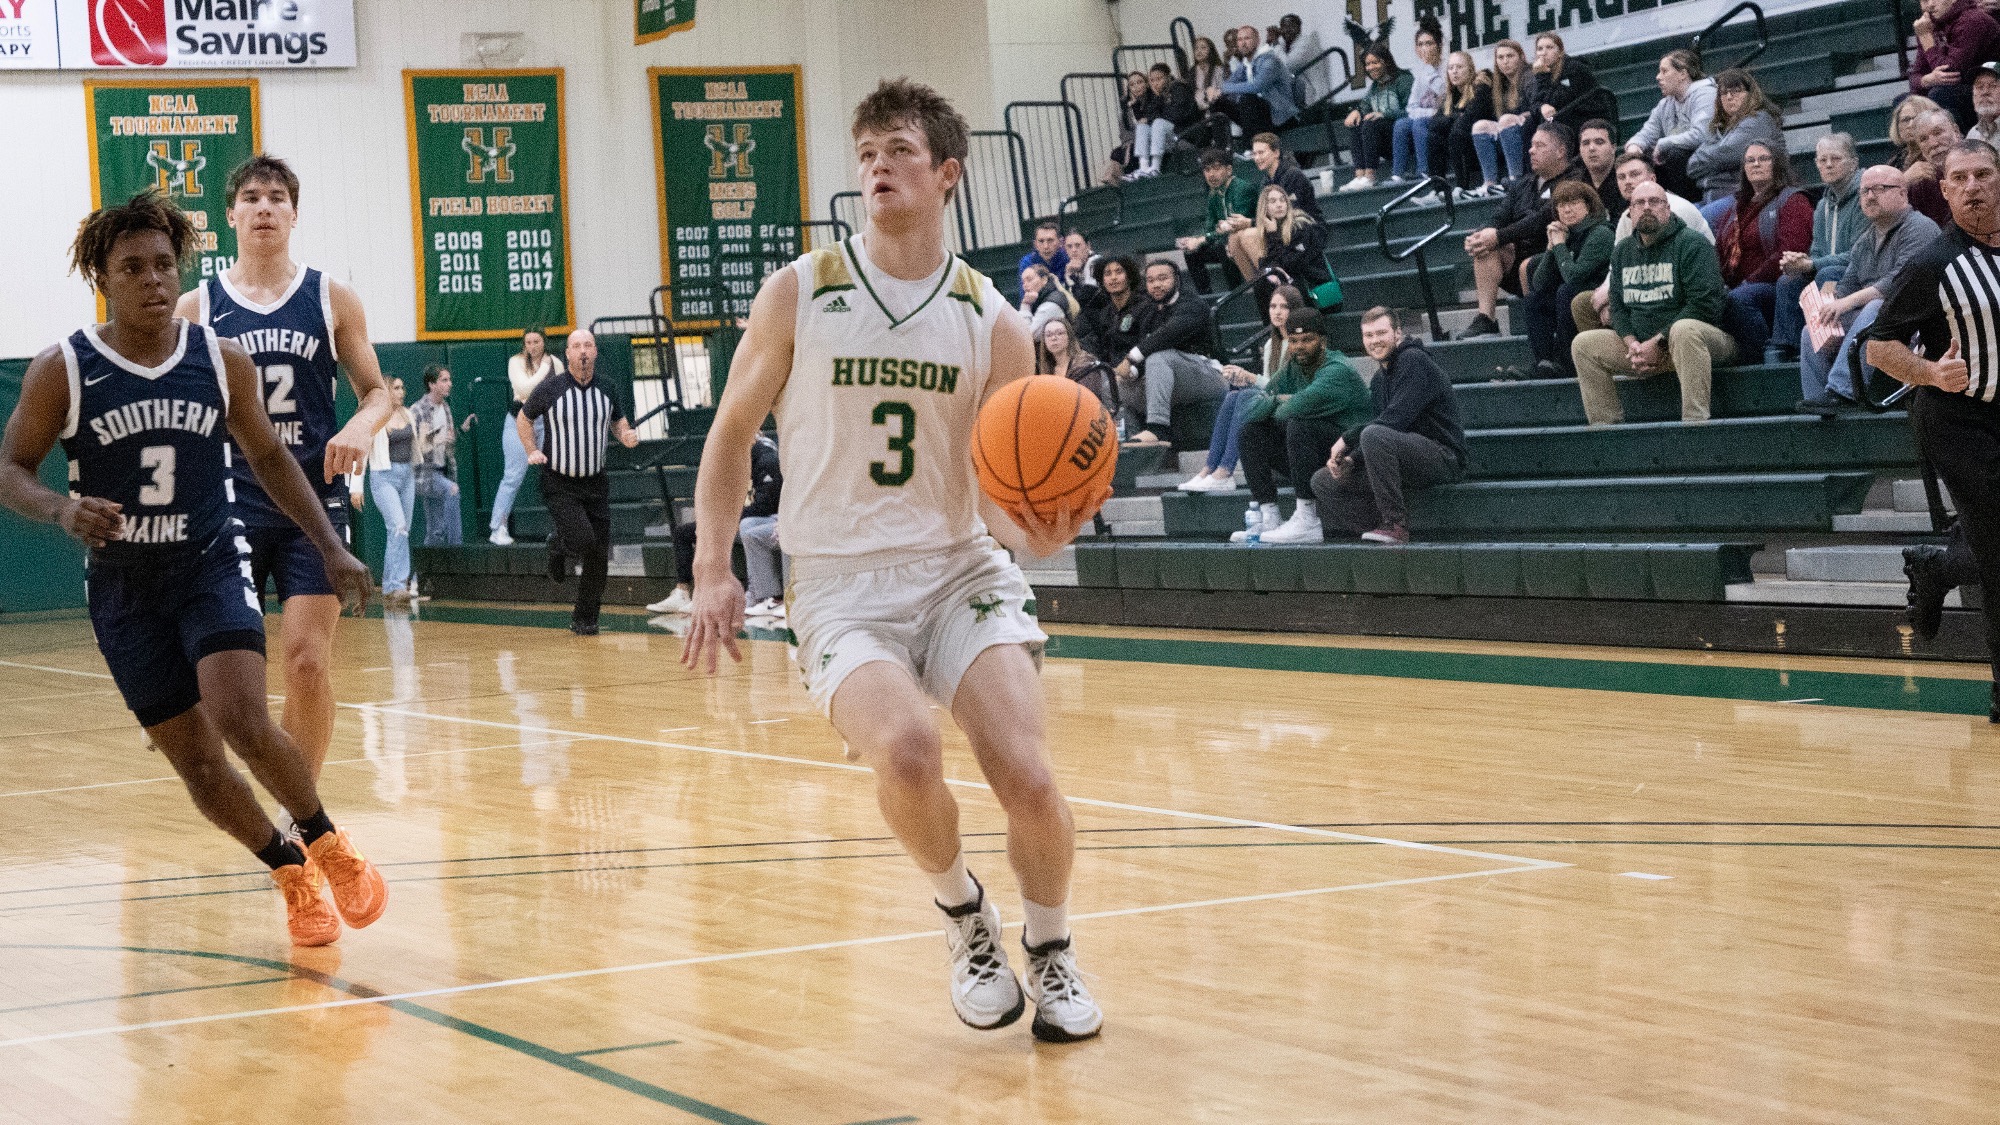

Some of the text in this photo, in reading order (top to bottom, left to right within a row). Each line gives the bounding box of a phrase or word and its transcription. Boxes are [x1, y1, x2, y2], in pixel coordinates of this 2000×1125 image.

[176, 23, 328, 64] Savings
[463, 83, 509, 103] NCAA
[704, 81, 748, 100] NCAA
[148, 94, 199, 115] NCAA
[428, 103, 546, 123] TOURNAMENT
[671, 100, 784, 120] TOURNAMENT
[110, 115, 239, 136] TOURNAMENT
[429, 194, 555, 216] FIELD HOCKEY
[711, 200, 755, 220] GOLF
[434, 229, 552, 251] 2009 2010
[676, 226, 709, 241] 2007
[440, 251, 553, 272] 2011 2014
[678, 244, 710, 260] 2010
[679, 263, 711, 278] 2013
[438, 272, 554, 293] 2015 2017
[682, 301, 714, 316] 2021
[231, 327, 321, 362] UTHERN
[832, 355, 961, 395] HUSSON
[89, 398, 219, 446] SOUTHERN
[869, 400, 917, 488] 3
[1068, 413, 1108, 472] Wils
[138, 444, 177, 506] 3
[119, 513, 190, 543] MAINE
